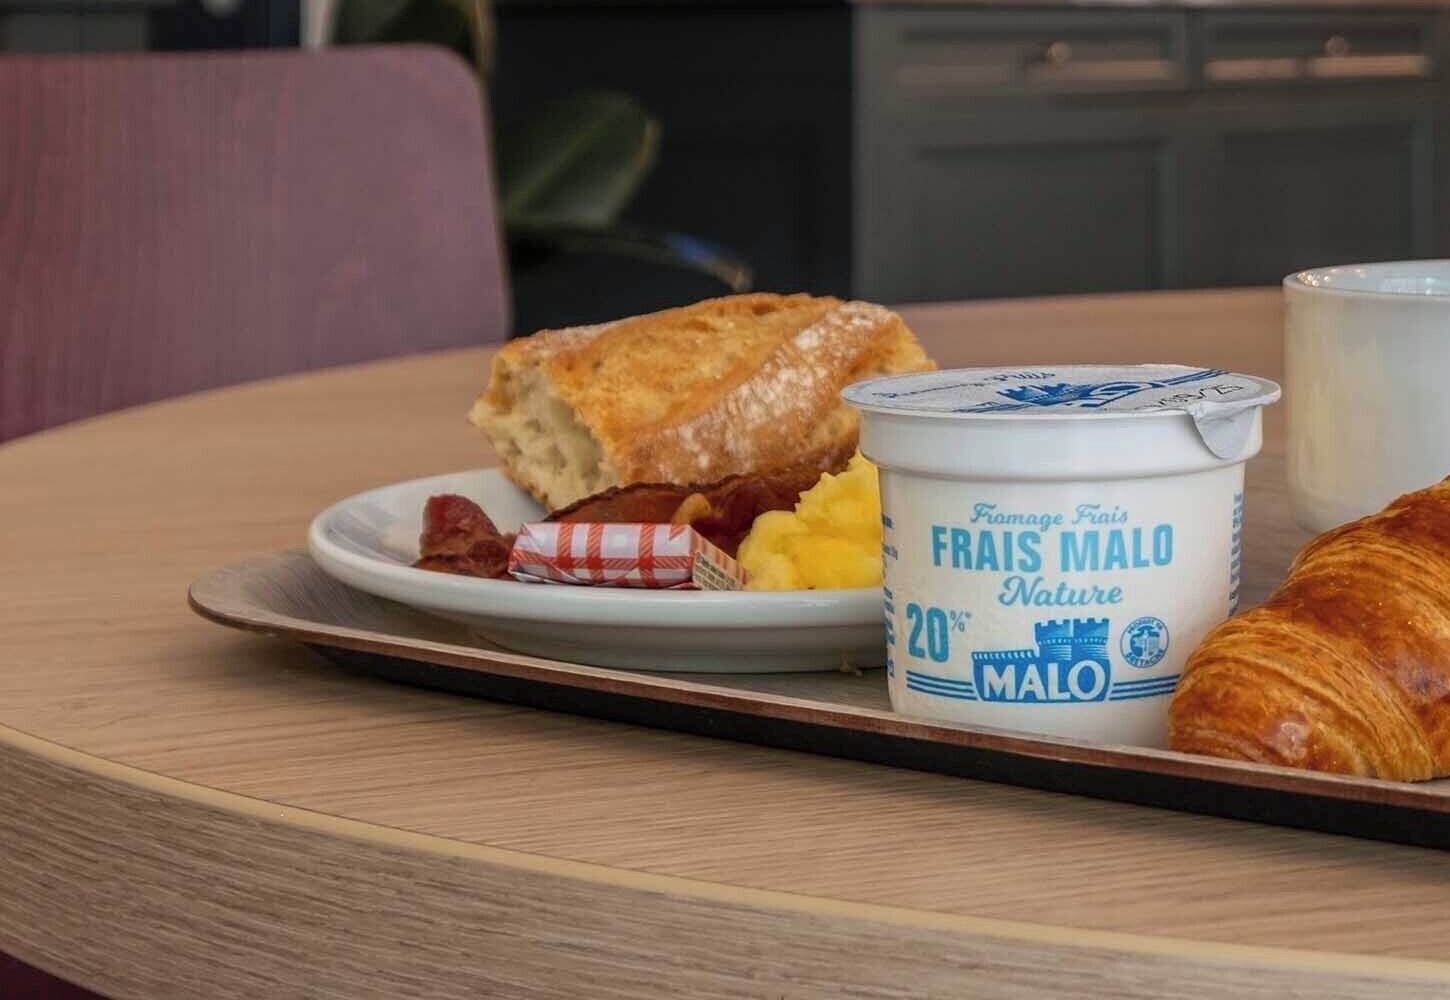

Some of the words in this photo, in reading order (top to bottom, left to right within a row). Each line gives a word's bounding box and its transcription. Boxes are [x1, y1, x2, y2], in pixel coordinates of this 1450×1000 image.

[970, 503, 1064, 531] Fromage
[1072, 503, 1128, 525] Frais
[932, 525, 1042, 573] FRAIS
[1060, 524, 1174, 573] MALO
[998, 576, 1123, 607] Nature
[982, 660, 1106, 700] MALO
